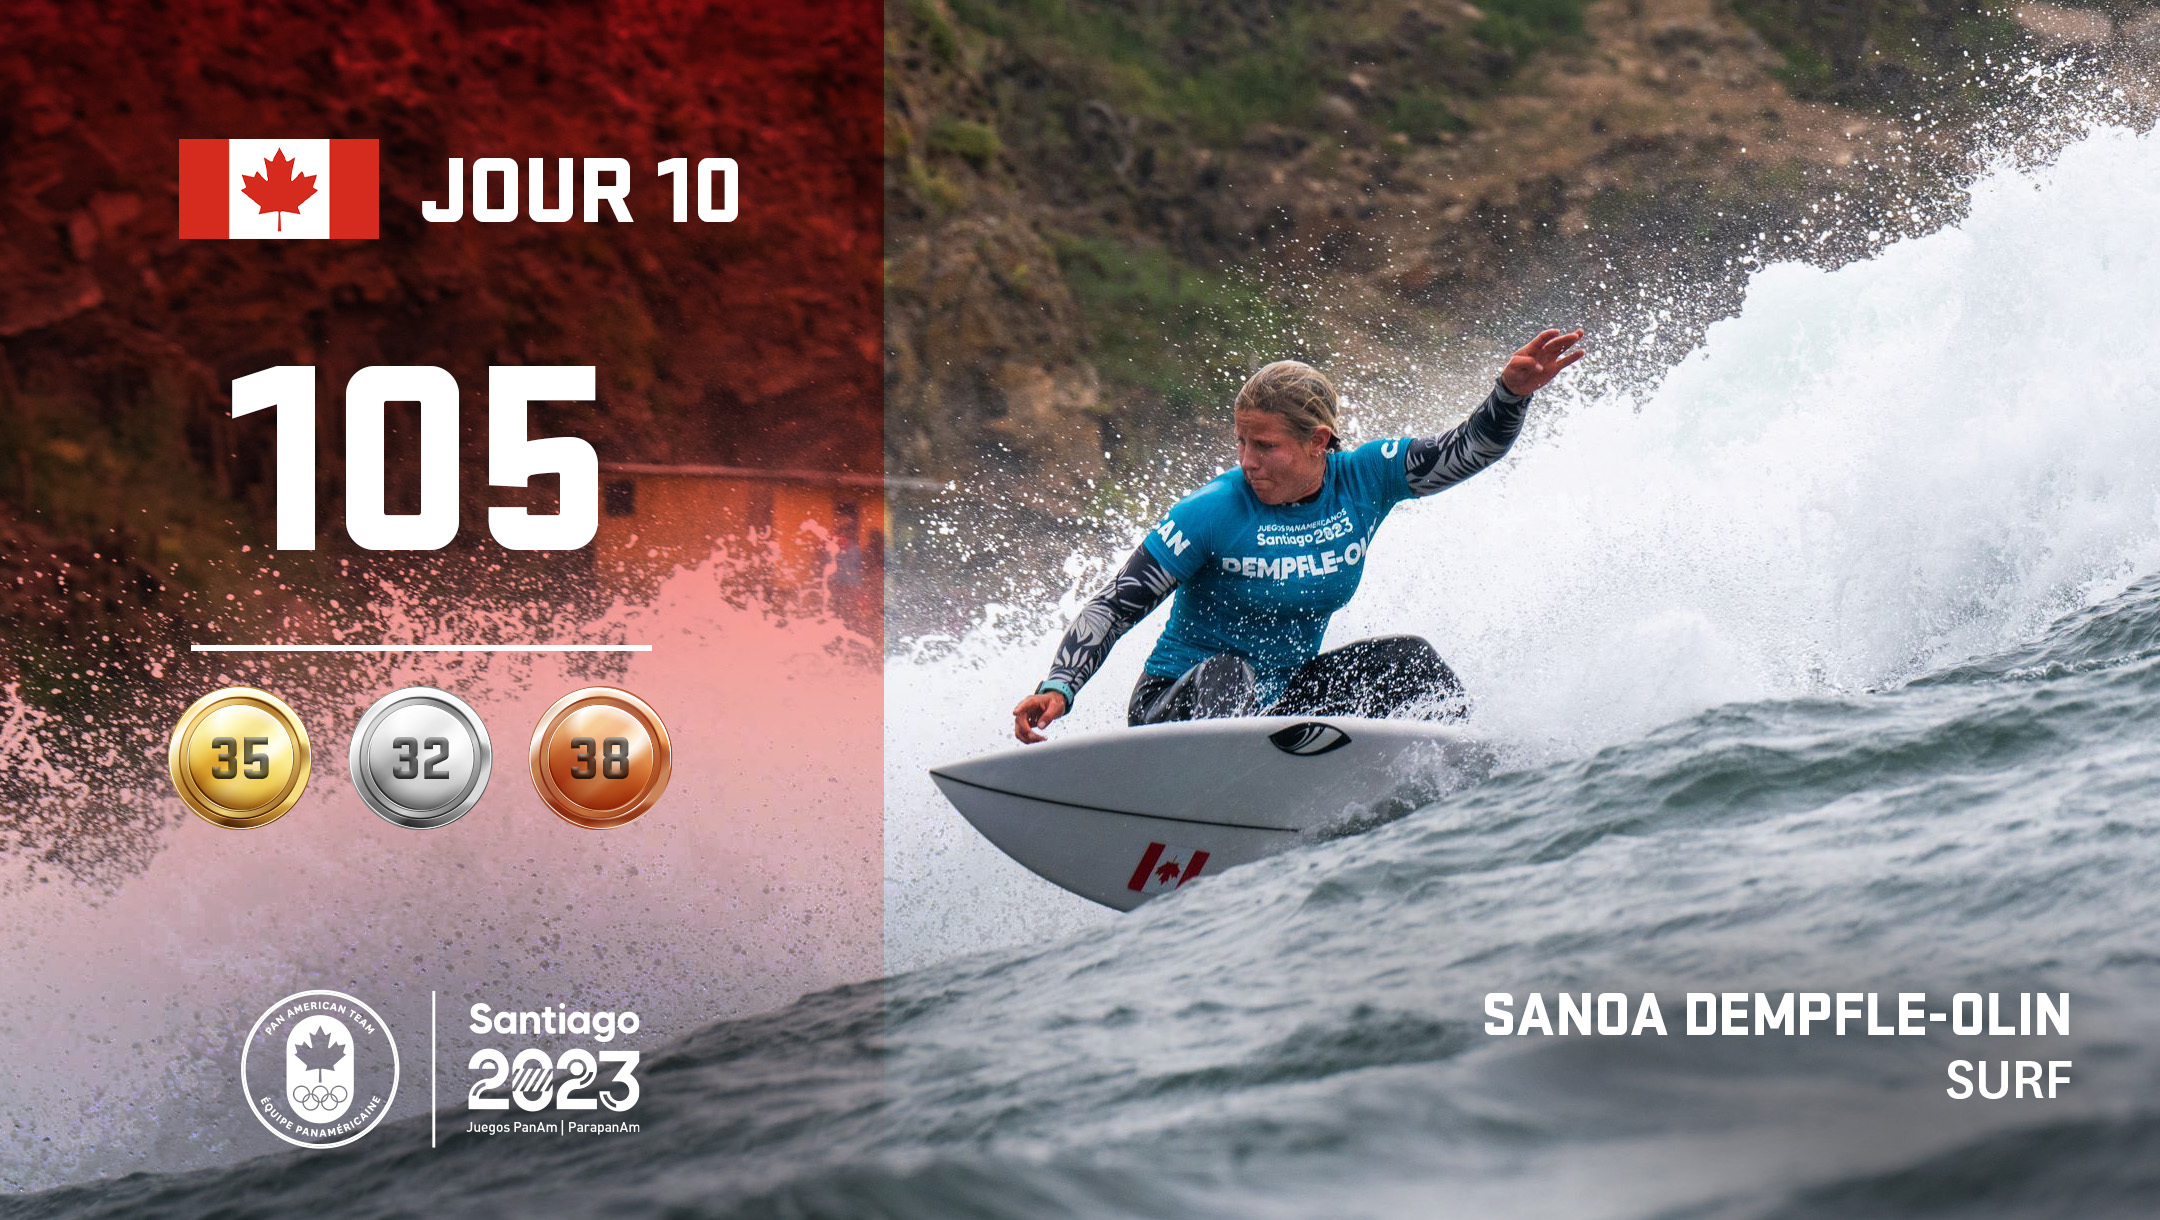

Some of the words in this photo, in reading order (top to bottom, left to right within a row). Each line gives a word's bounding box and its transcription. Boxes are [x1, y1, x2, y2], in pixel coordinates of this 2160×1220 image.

[1256, 532, 1314, 547] Santiago
[1314, 516, 1354, 545] 2023
[1257, 524, 1285, 533] JUEGOS
[1286, 508, 1347, 533] PANAMERICANOS
